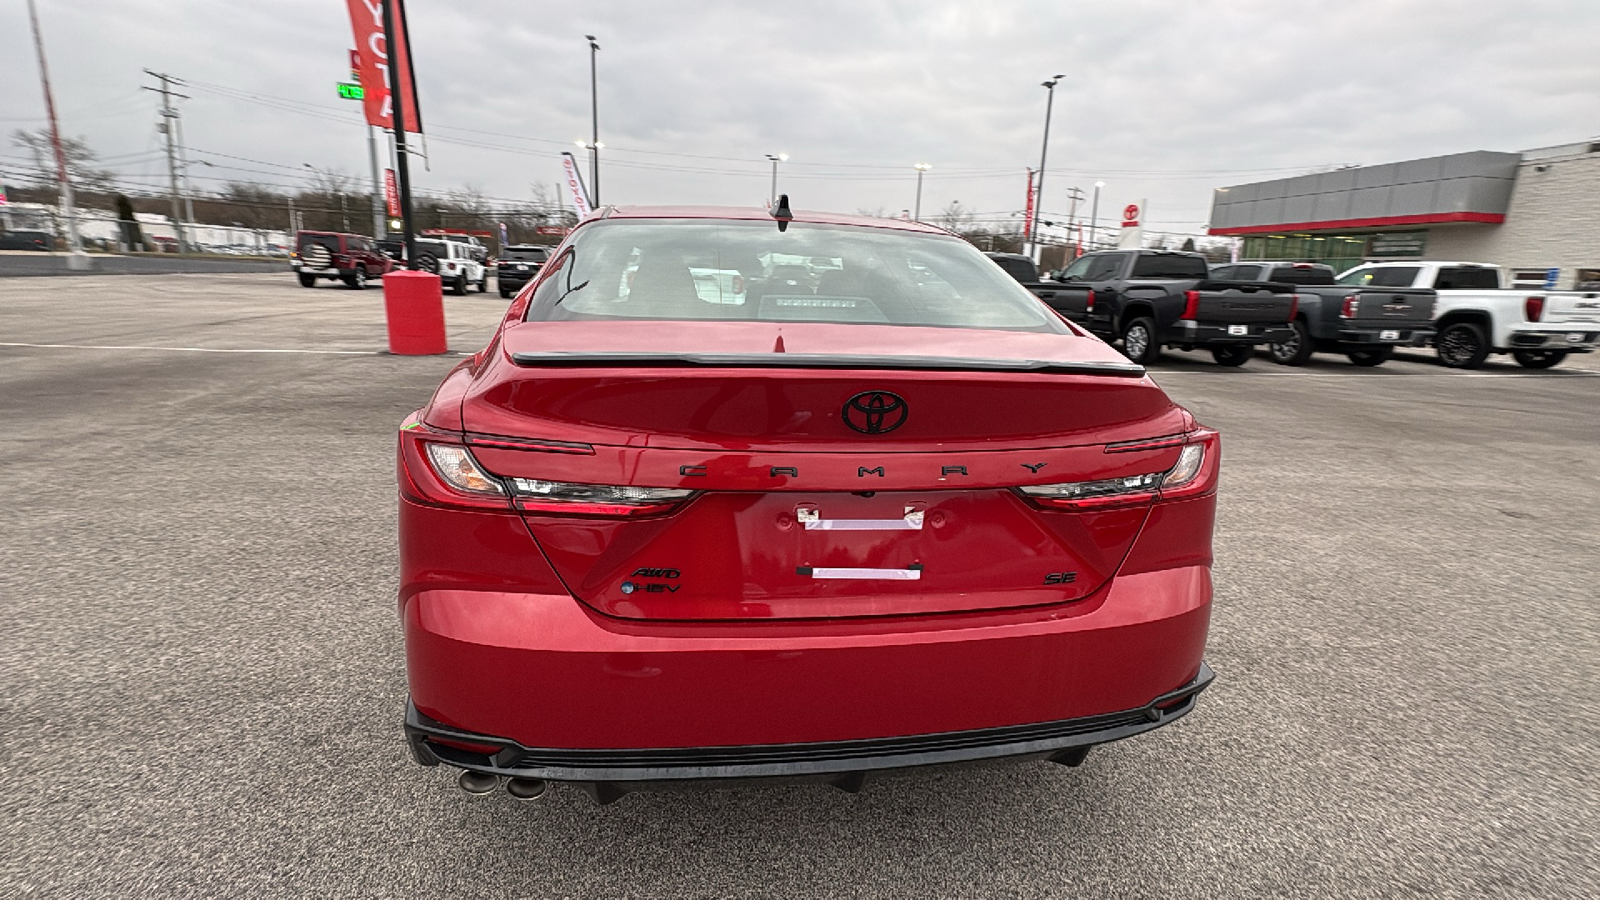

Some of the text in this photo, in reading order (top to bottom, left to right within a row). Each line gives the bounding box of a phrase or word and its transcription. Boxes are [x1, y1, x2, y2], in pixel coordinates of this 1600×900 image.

[680, 462, 1048, 478] CAMRY
[630, 567, 681, 578] AWD
[1043, 571, 1078, 585] SE
[634, 583, 681, 593] HEV
